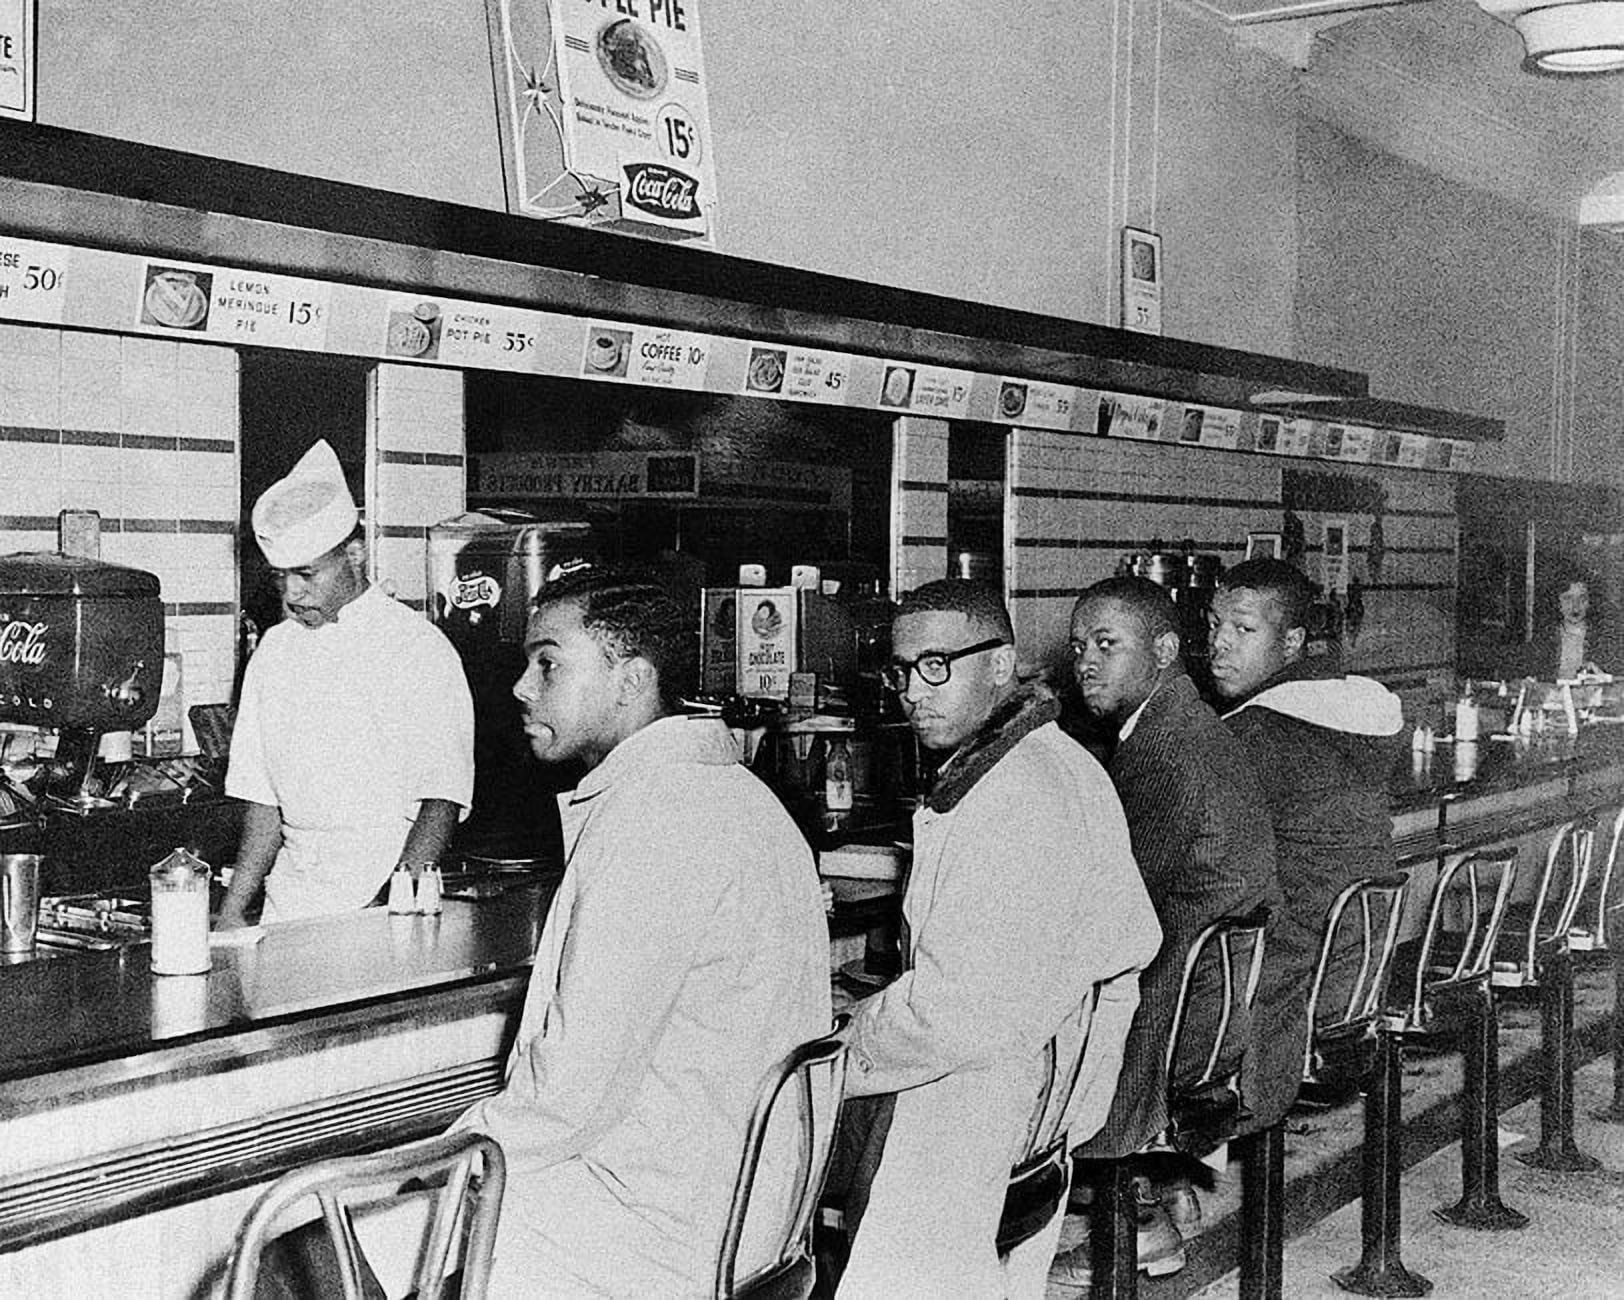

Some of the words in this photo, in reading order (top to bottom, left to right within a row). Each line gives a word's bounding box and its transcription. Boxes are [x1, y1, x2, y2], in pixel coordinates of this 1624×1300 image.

[650, 0, 686, 31] PIE
[229, 280, 270, 295] LEMON
[218, 297, 278, 315] MERINGUE
[236, 319, 257, 333] PIE
[446, 327, 469, 341] POT
[473, 331, 491, 345] PIE
[640, 342, 683, 362] COFFEE
